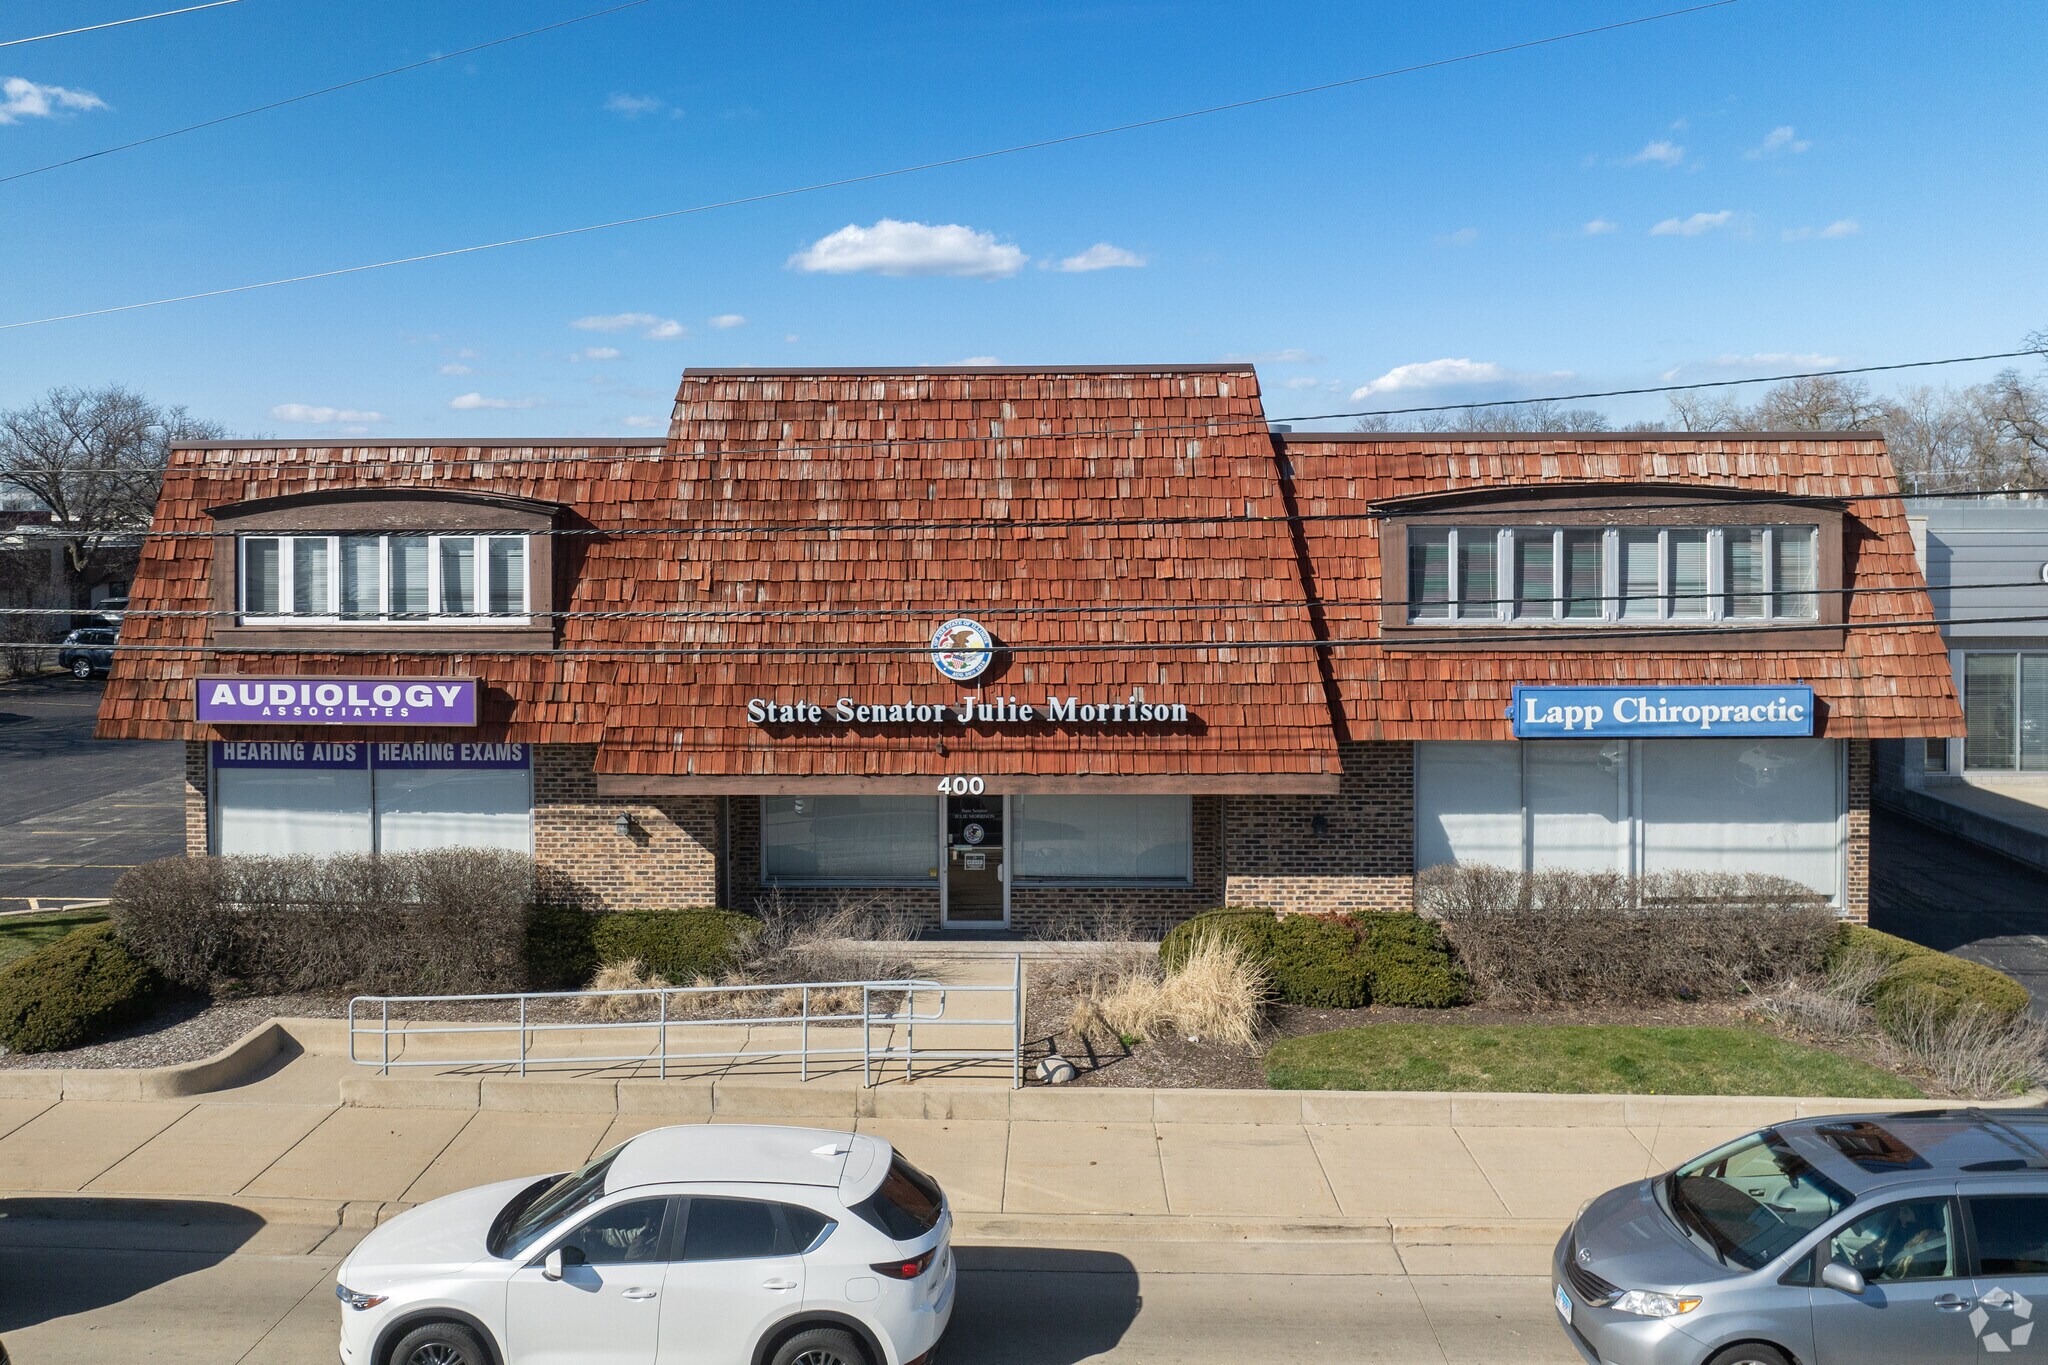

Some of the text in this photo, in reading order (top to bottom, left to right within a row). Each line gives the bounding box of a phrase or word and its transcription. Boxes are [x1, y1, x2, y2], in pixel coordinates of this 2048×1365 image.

[946, 621, 962, 629] STATE
[210, 684, 462, 707] AUDIOLOGY
[262, 706, 409, 717] ASSOCIATES
[747, 696, 1189, 723] State Senator Julie Morrison
[1524, 696, 1804, 730] Lapp Chiropractic
[223, 743, 357, 762] HEARING AIDS
[378, 743, 523, 762] HEARING EXAMS
[937, 776, 985, 795] 400
